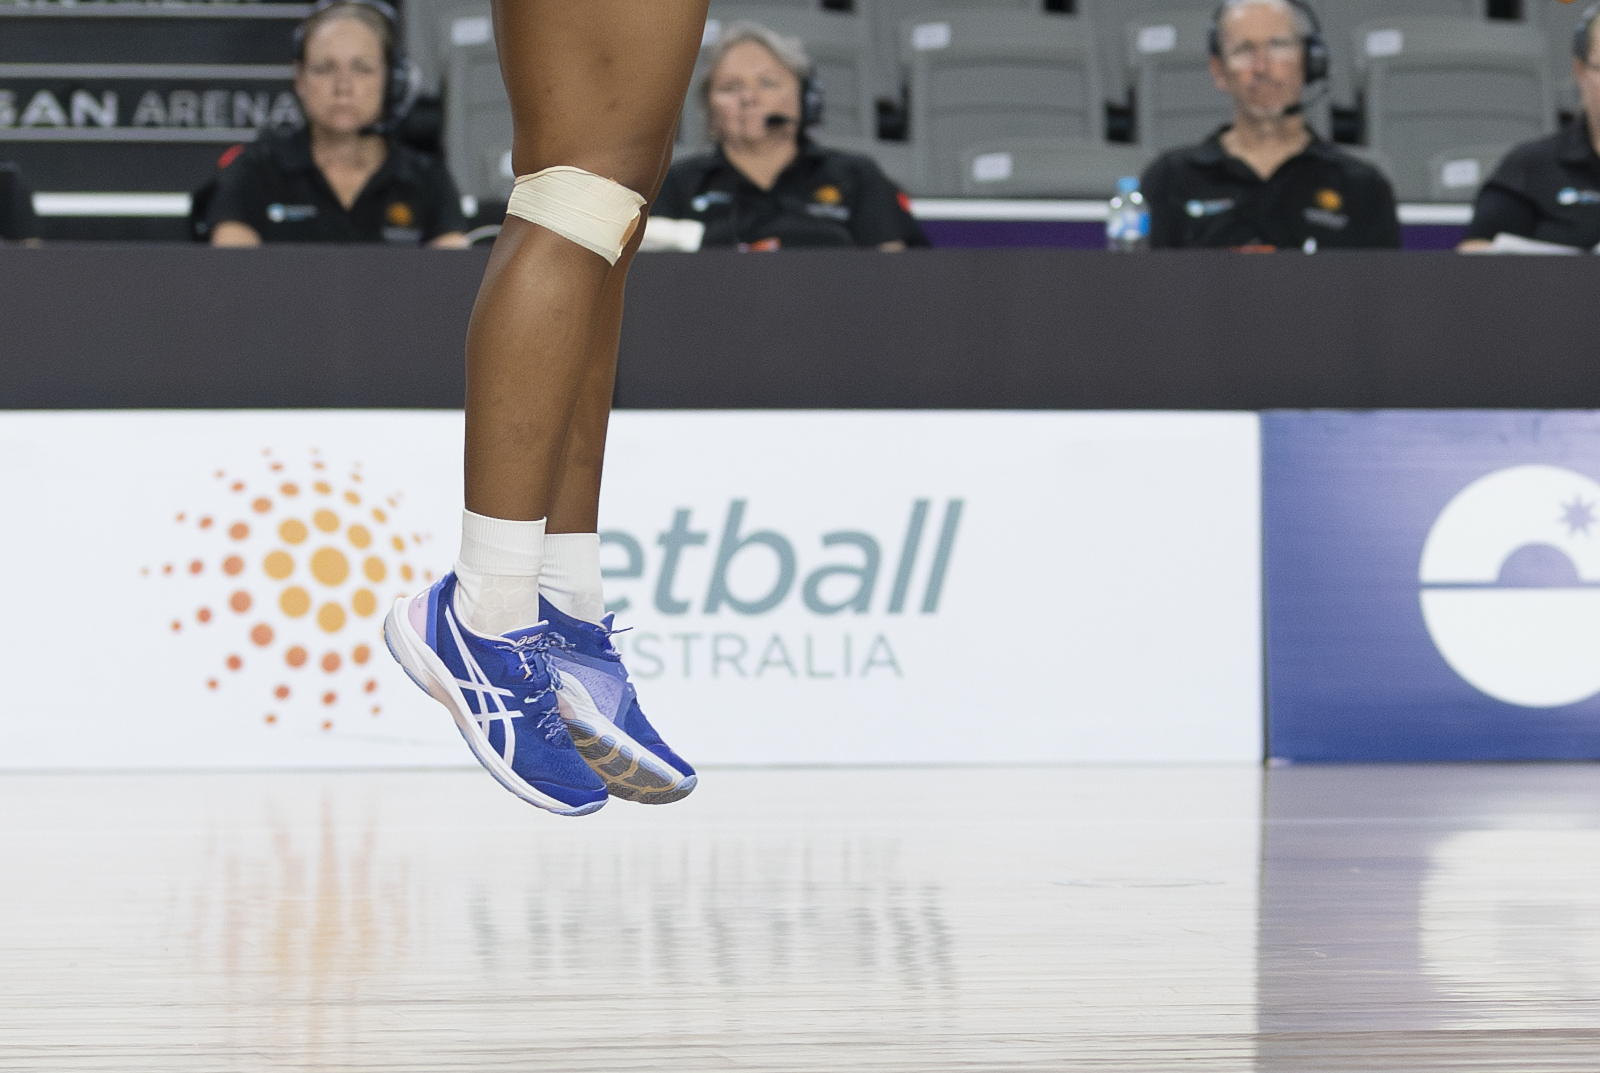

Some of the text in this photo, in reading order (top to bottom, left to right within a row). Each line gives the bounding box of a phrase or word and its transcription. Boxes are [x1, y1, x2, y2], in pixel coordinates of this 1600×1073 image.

[132, 88, 305, 128] ARENA
[600, 498, 964, 616] etball
[617, 632, 904, 680] STRALIA
